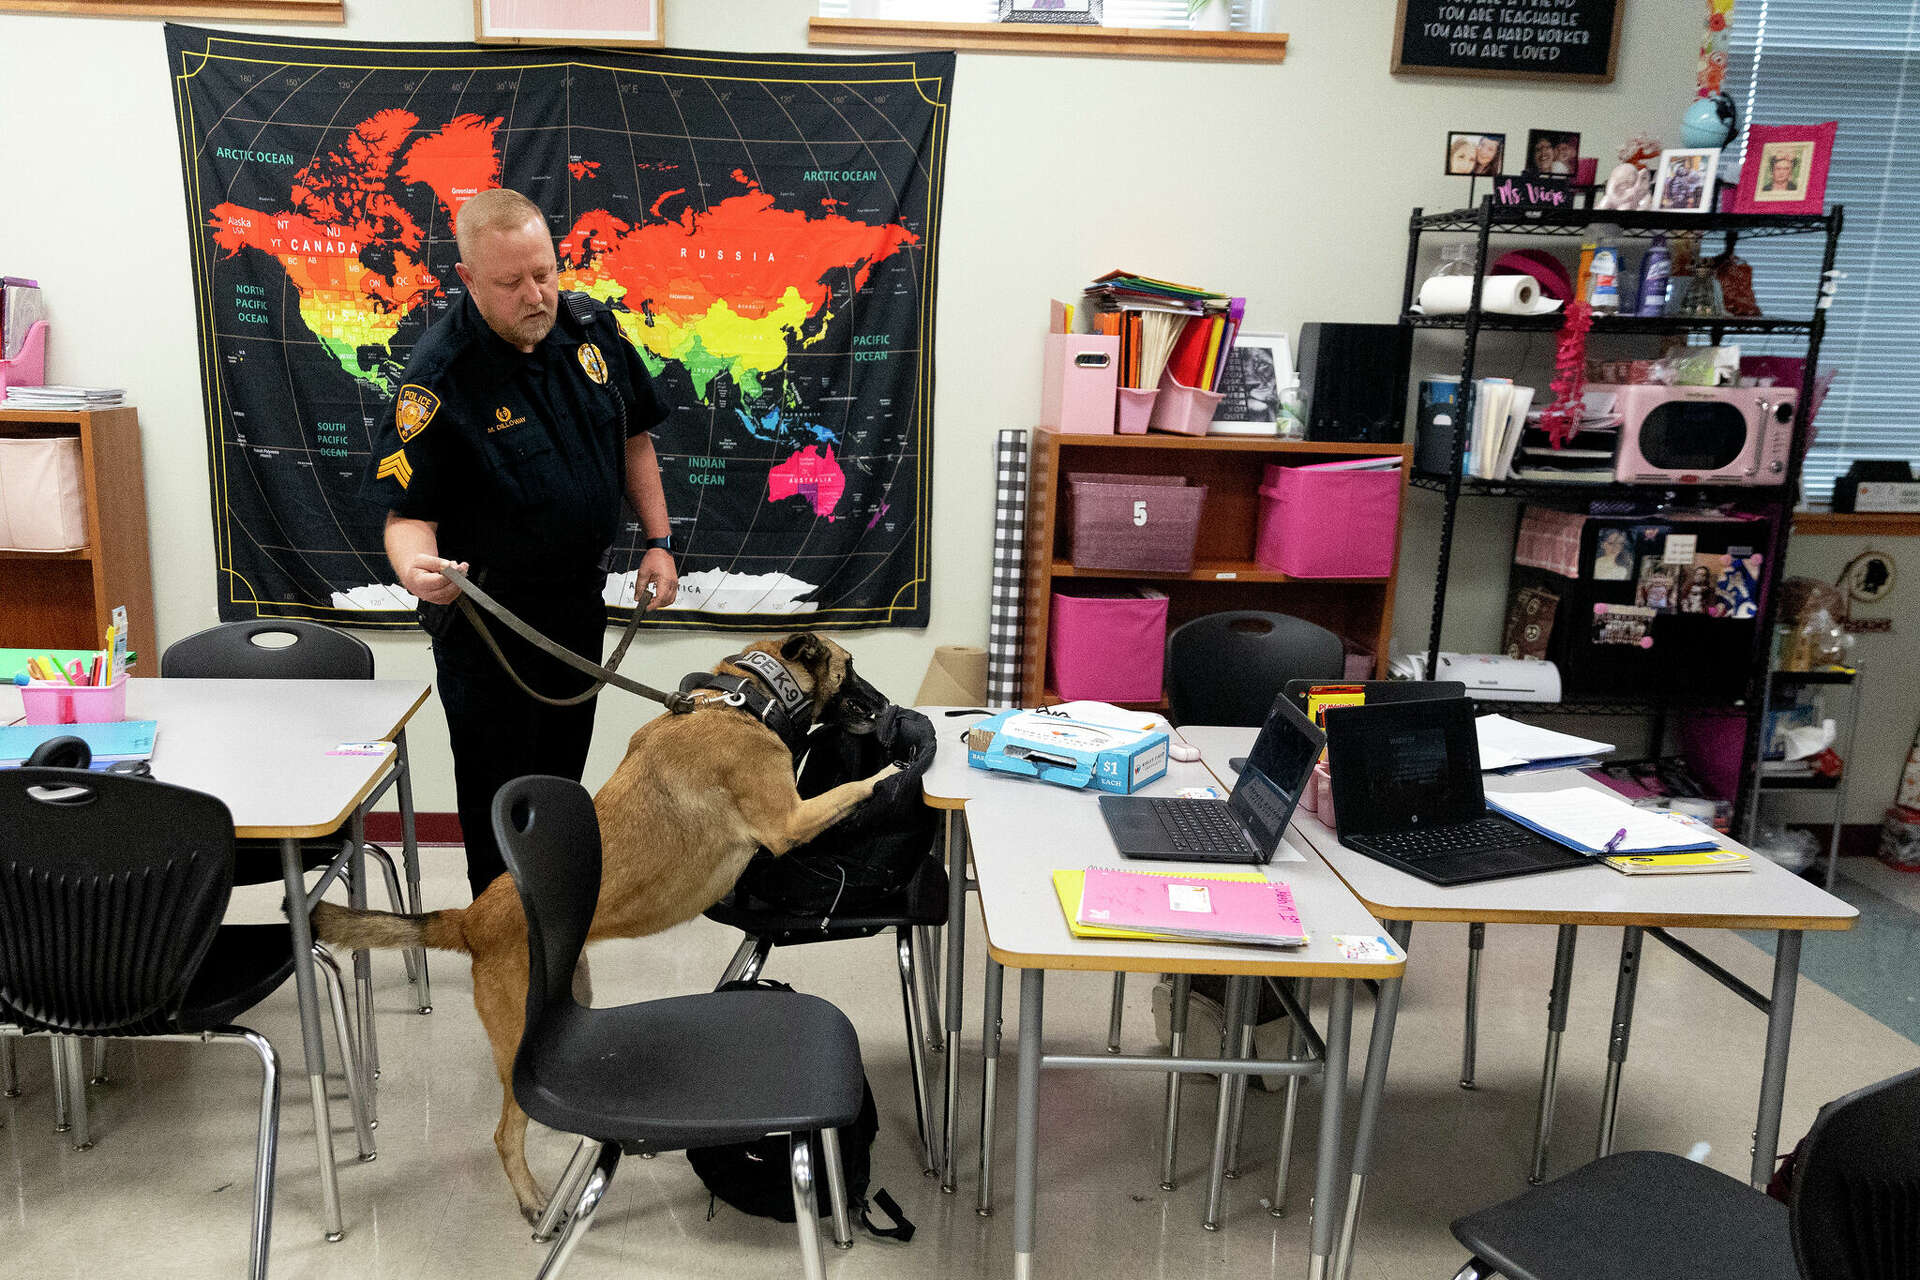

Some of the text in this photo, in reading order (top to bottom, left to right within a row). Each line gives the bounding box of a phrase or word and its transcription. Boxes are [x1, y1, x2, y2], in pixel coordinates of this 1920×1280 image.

[1438, 6, 1580, 26] YOU ARE TEACHABLE
[1423, 23, 1590, 45] YOU ARE A HARD WORKER
[1449, 42, 1561, 61] YOU ARE LOVED
[216, 147, 294, 165] ARCTIC OCEAN
[803, 170, 877, 182] ARCTIC OCEAN
[451, 187, 478, 195] Greenland
[228, 216, 251, 228] Alaska
[277, 219, 289, 230] NT
[232, 227, 245, 235] USA
[327, 226, 341, 238] NU
[270, 238, 282, 248] YT
[291, 238, 358, 255] CANADA
[680, 247, 776, 263] RUSSIA
[369, 280, 381, 288] ON
[396, 276, 409, 287] QC
[422, 274, 435, 284] NL
[235, 284, 265, 296] NORTH
[235, 298, 268, 311] PACIFIC
[238, 312, 269, 325] OCEAN
[853, 335, 891, 346] PACIFIC
[854, 350, 888, 362] OCEAN
[403, 390, 432, 409] POLICE
[317, 422, 346, 432] SOUTH
[317, 435, 348, 445] PACIFIC
[320, 448, 348, 457] OCEAN
[688, 457, 726, 470] INDIAN
[689, 473, 726, 486] OCEAN
[1132, 500, 1148, 527] 5
[773, 671, 800, 703] K-9
[1103, 760, 1118, 775] $1
[1101, 778, 1122, 787] EACH
